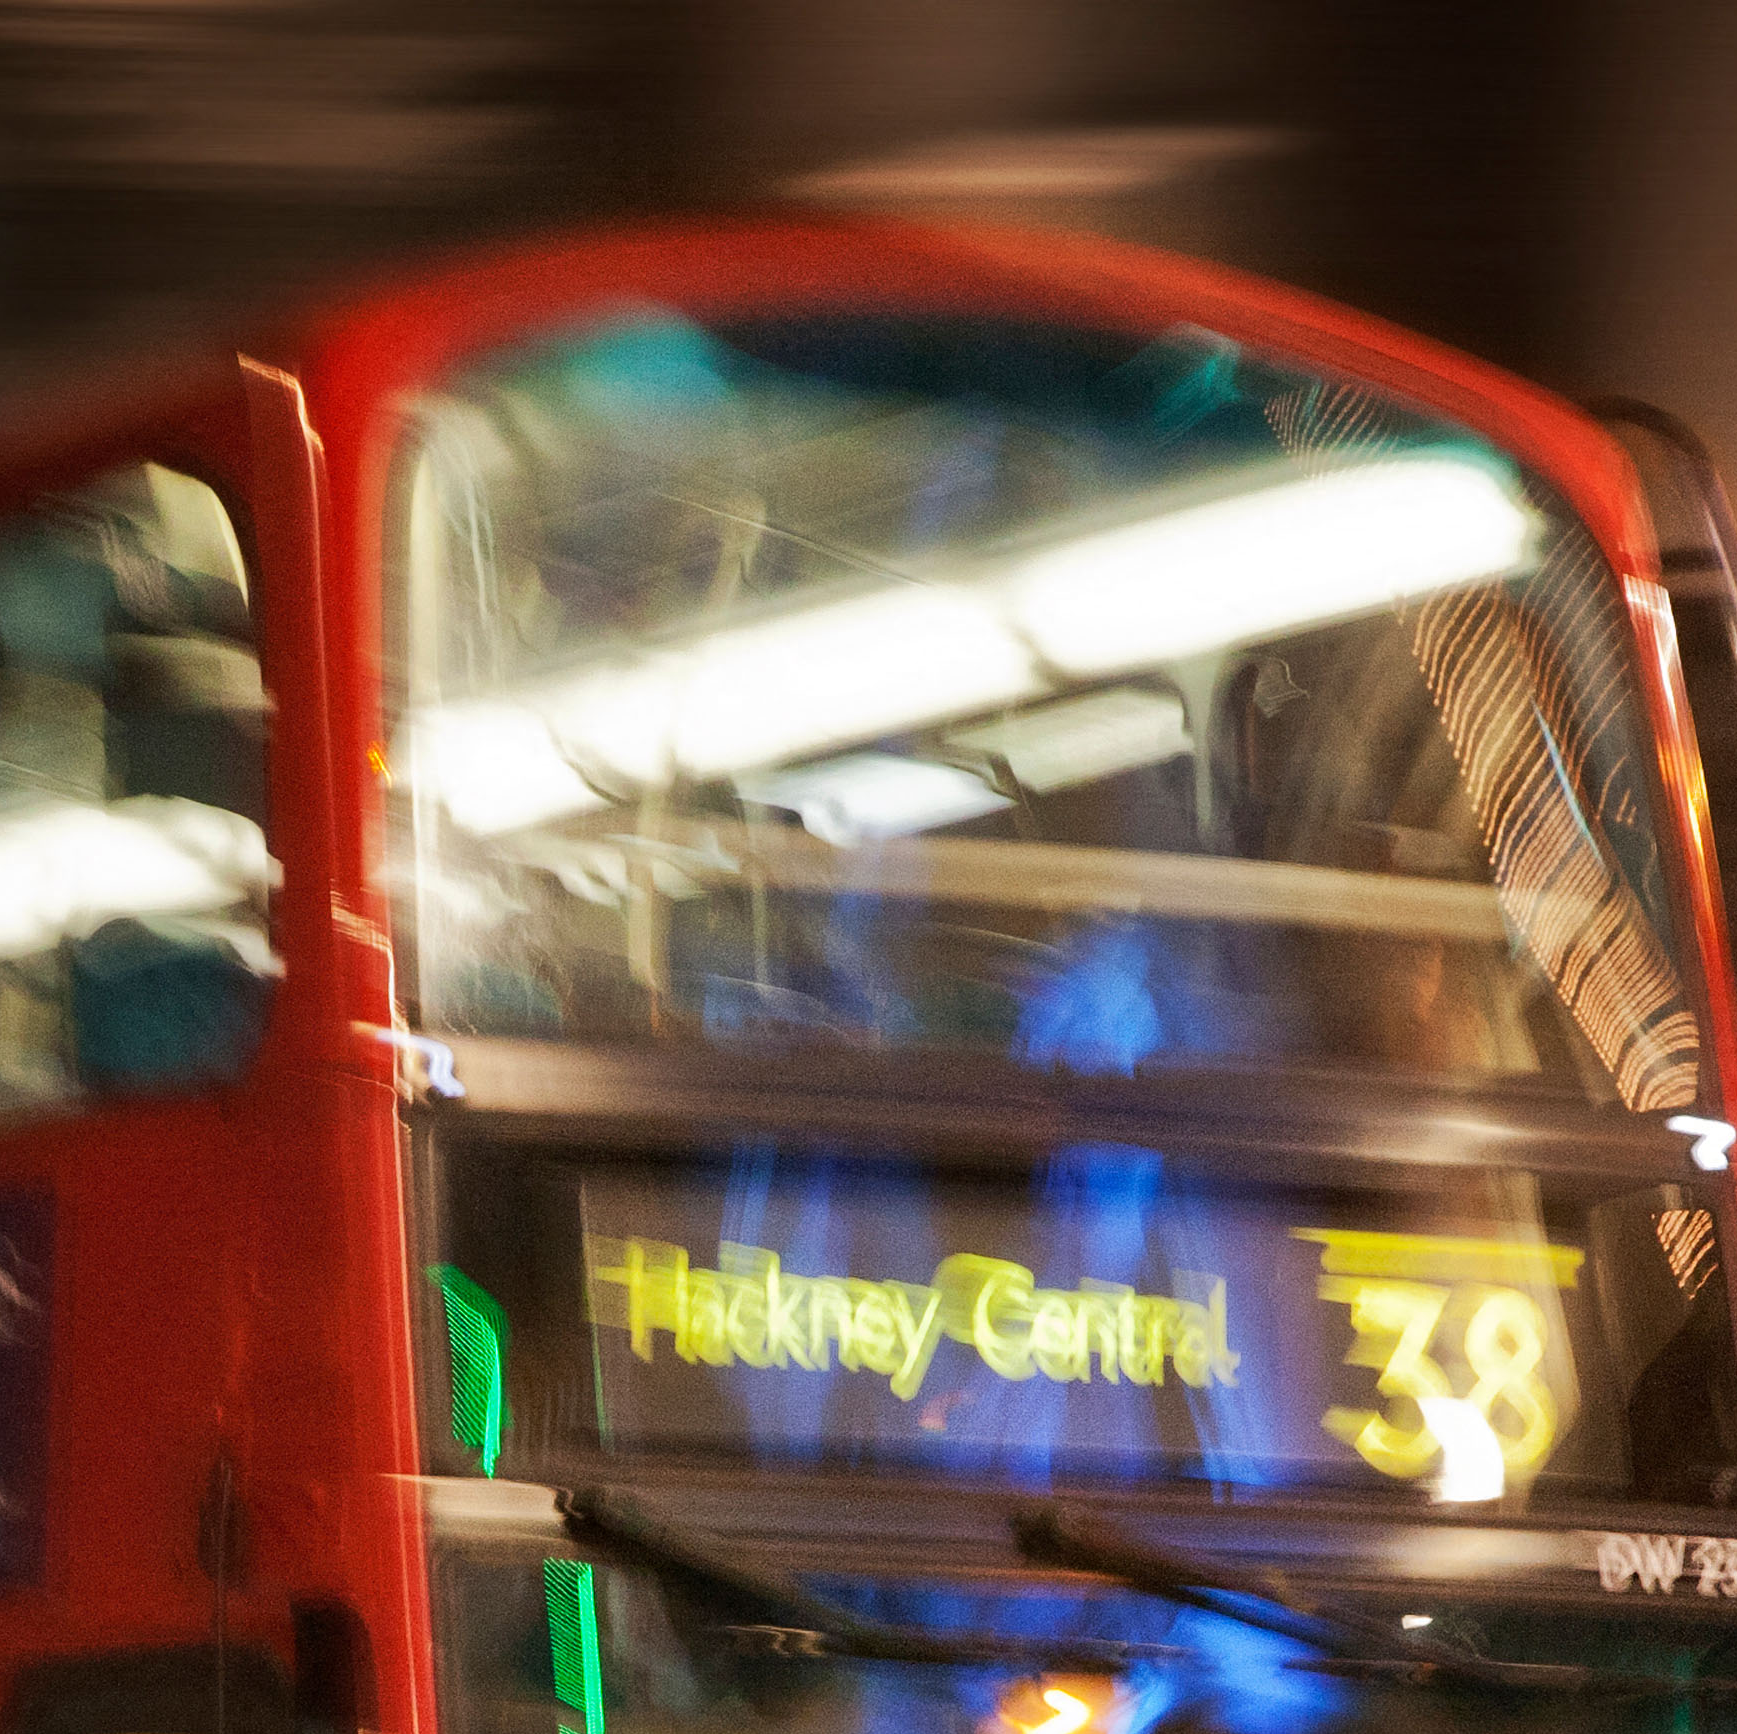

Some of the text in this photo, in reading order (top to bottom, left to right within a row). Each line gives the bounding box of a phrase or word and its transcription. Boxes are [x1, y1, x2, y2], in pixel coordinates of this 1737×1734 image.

[598, 1235, 1241, 1402] Hackney Central
[1342, 1276, 1560, 1482] 38
[1597, 1531, 1687, 1596] DW
